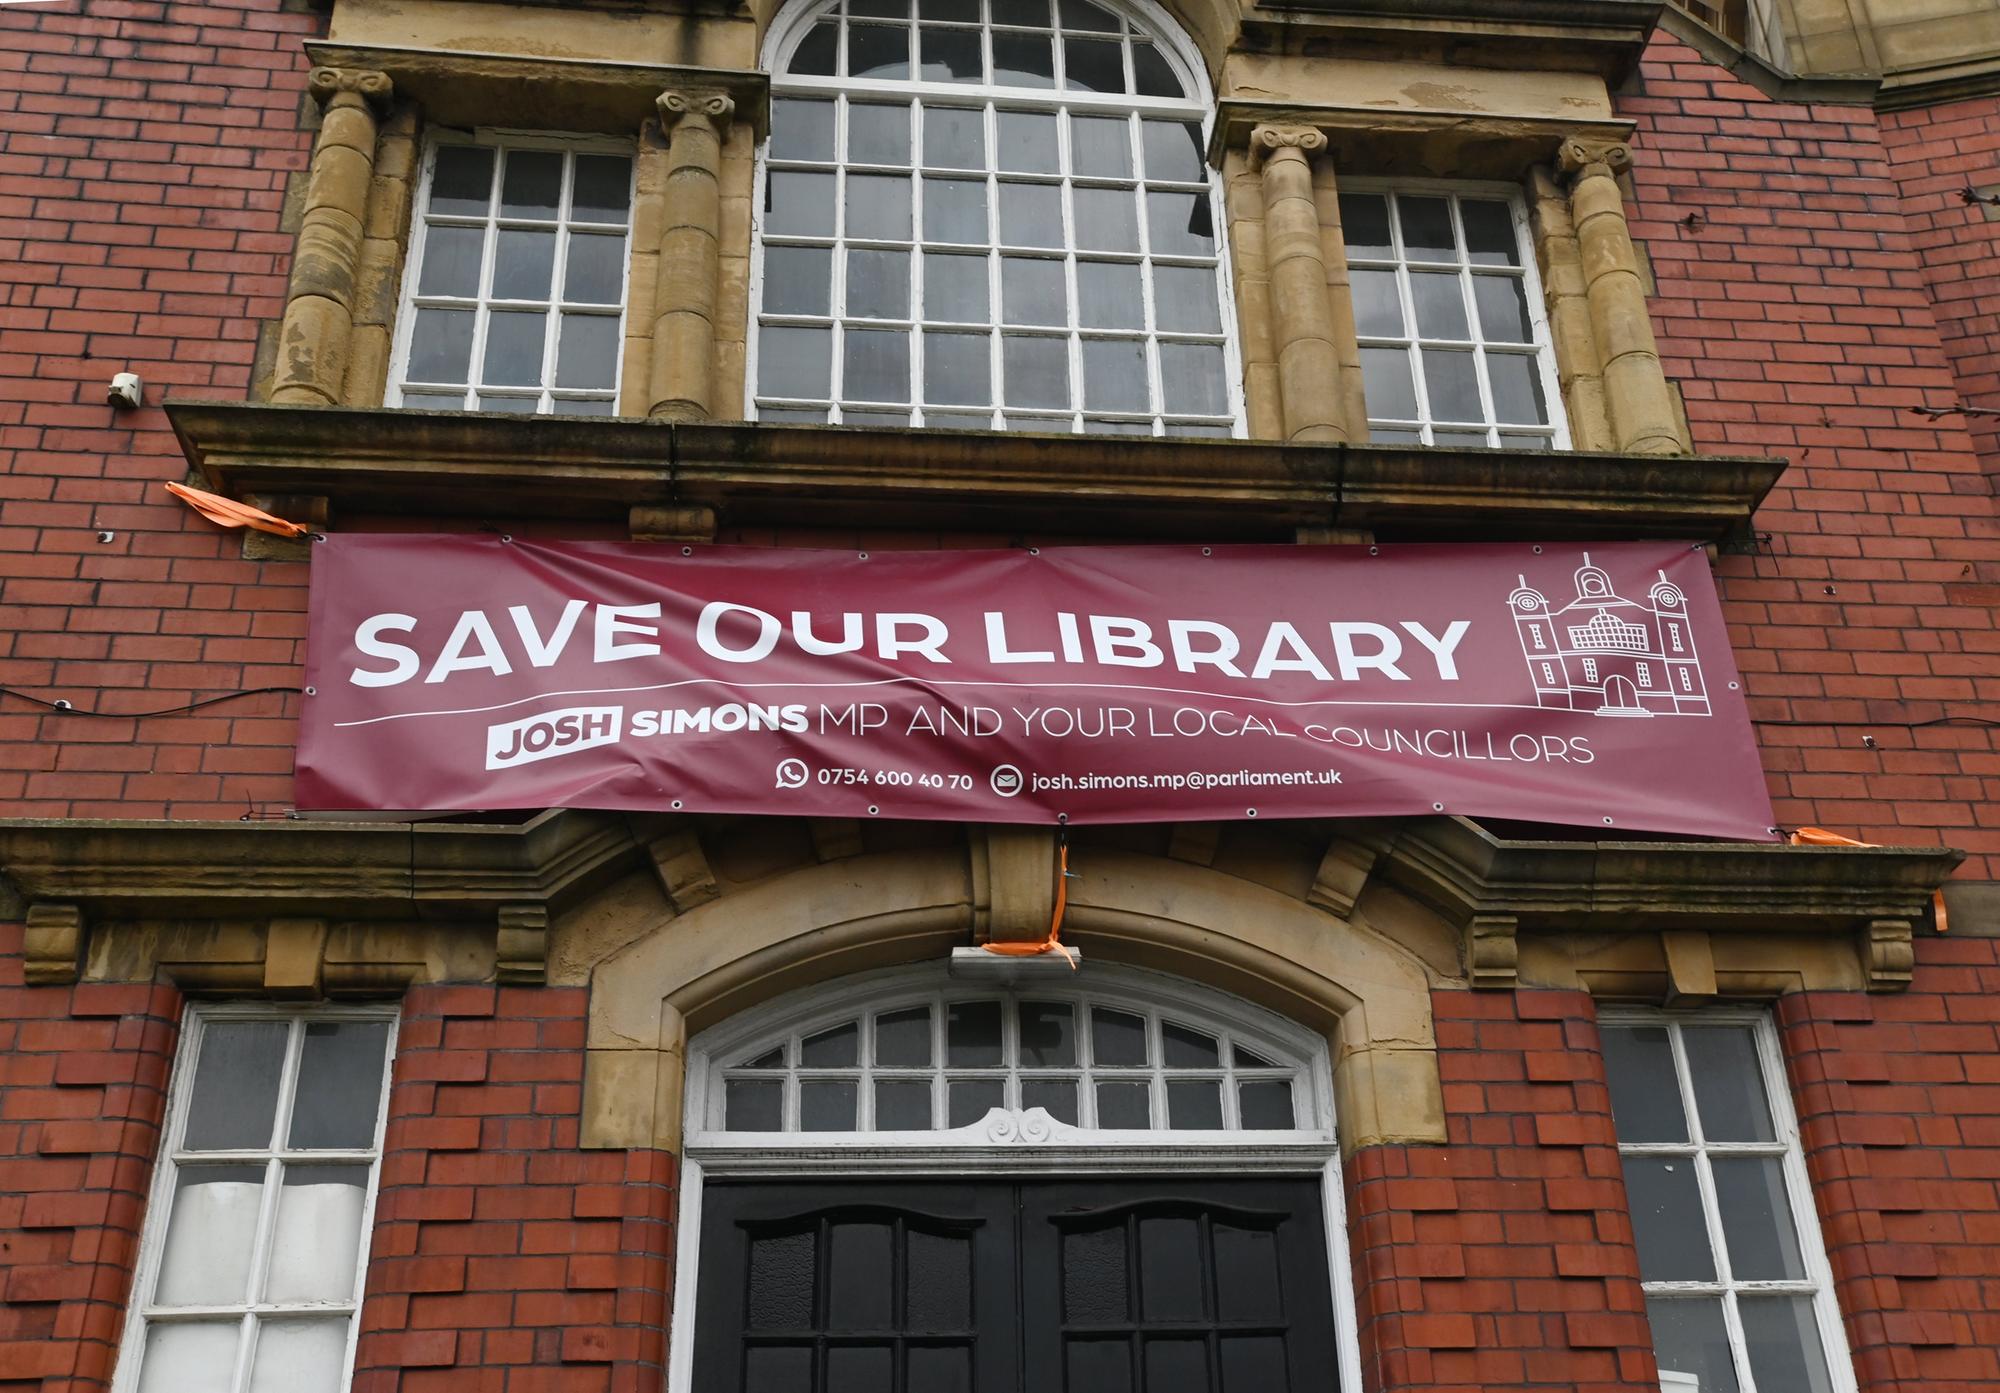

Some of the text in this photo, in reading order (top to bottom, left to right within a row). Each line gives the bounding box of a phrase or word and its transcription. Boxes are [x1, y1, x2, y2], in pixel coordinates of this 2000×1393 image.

[348, 599, 1472, 688] SAVE OUR LIBRARY
[494, 702, 1595, 764] JOSH SIMONS MP AND YOUR LOCAL COUNCILLORS
[817, 768, 973, 791] 0754 600 40 70
[1030, 769, 1343, 793] josh.simons.mp@parliament.uk
